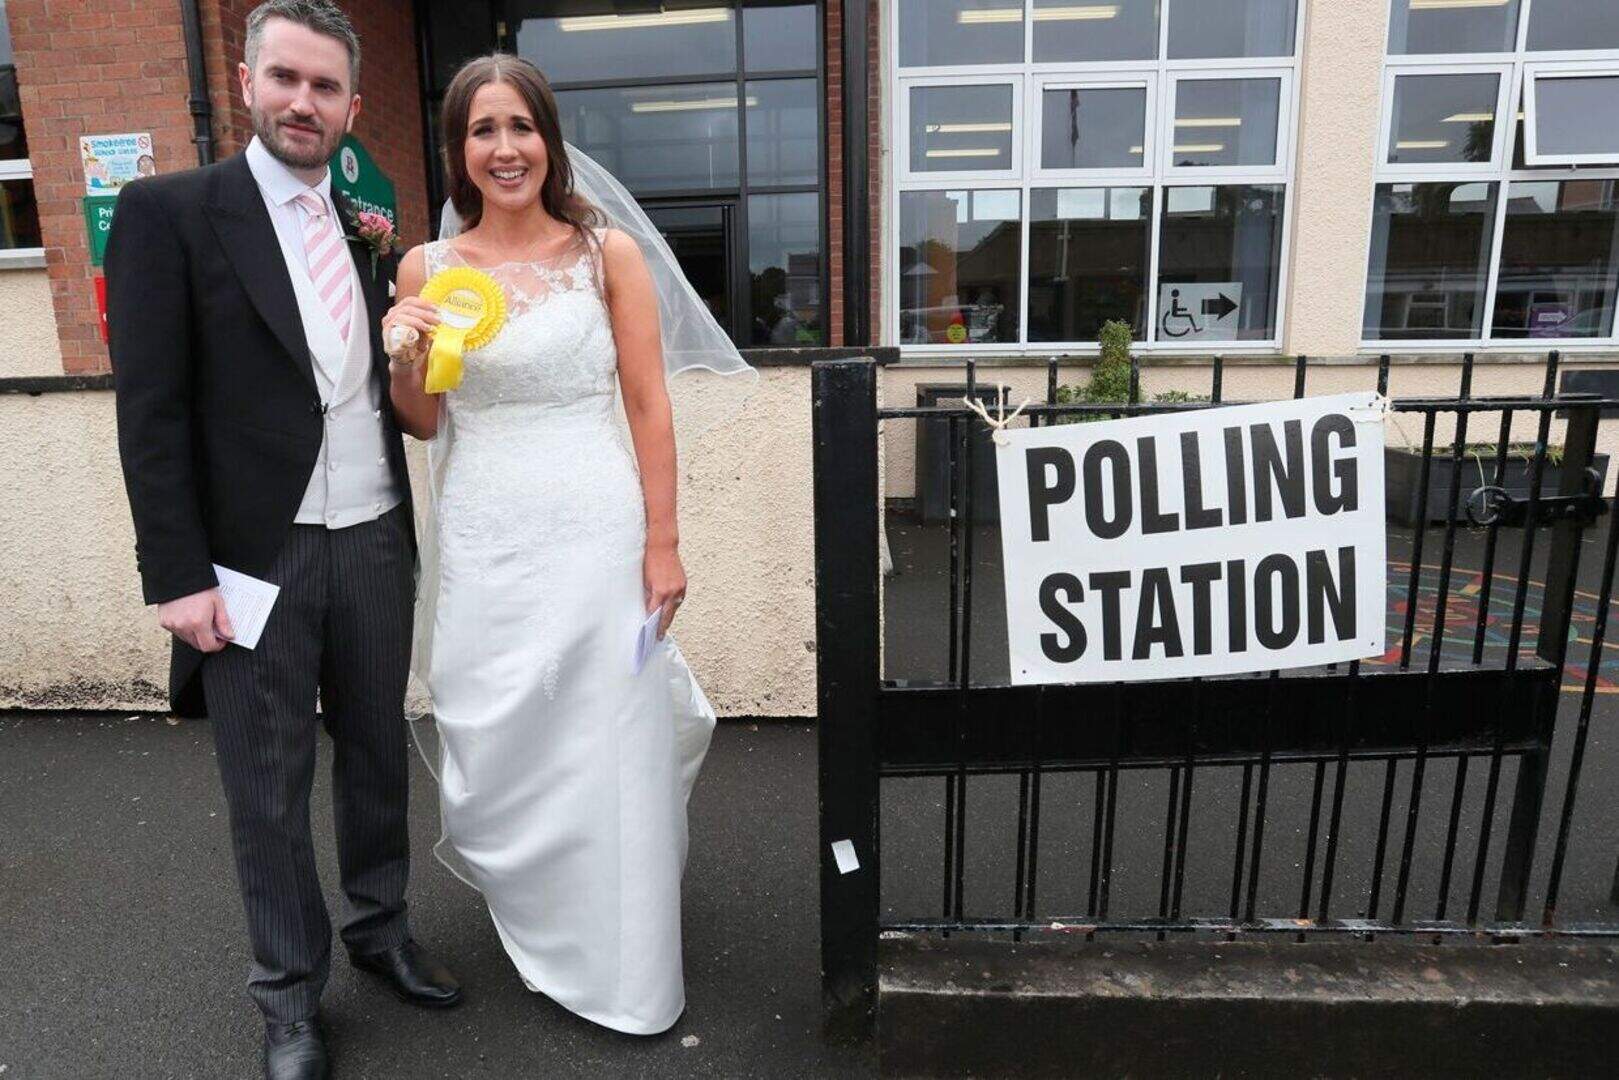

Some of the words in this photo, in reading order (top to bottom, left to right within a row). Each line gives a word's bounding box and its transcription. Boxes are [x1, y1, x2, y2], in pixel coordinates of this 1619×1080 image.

[98, 207, 114, 218] Pri
[342, 190, 394, 222] ntrance
[1026, 413, 1359, 542] POLLING
[1038, 546, 1357, 663] STATION
